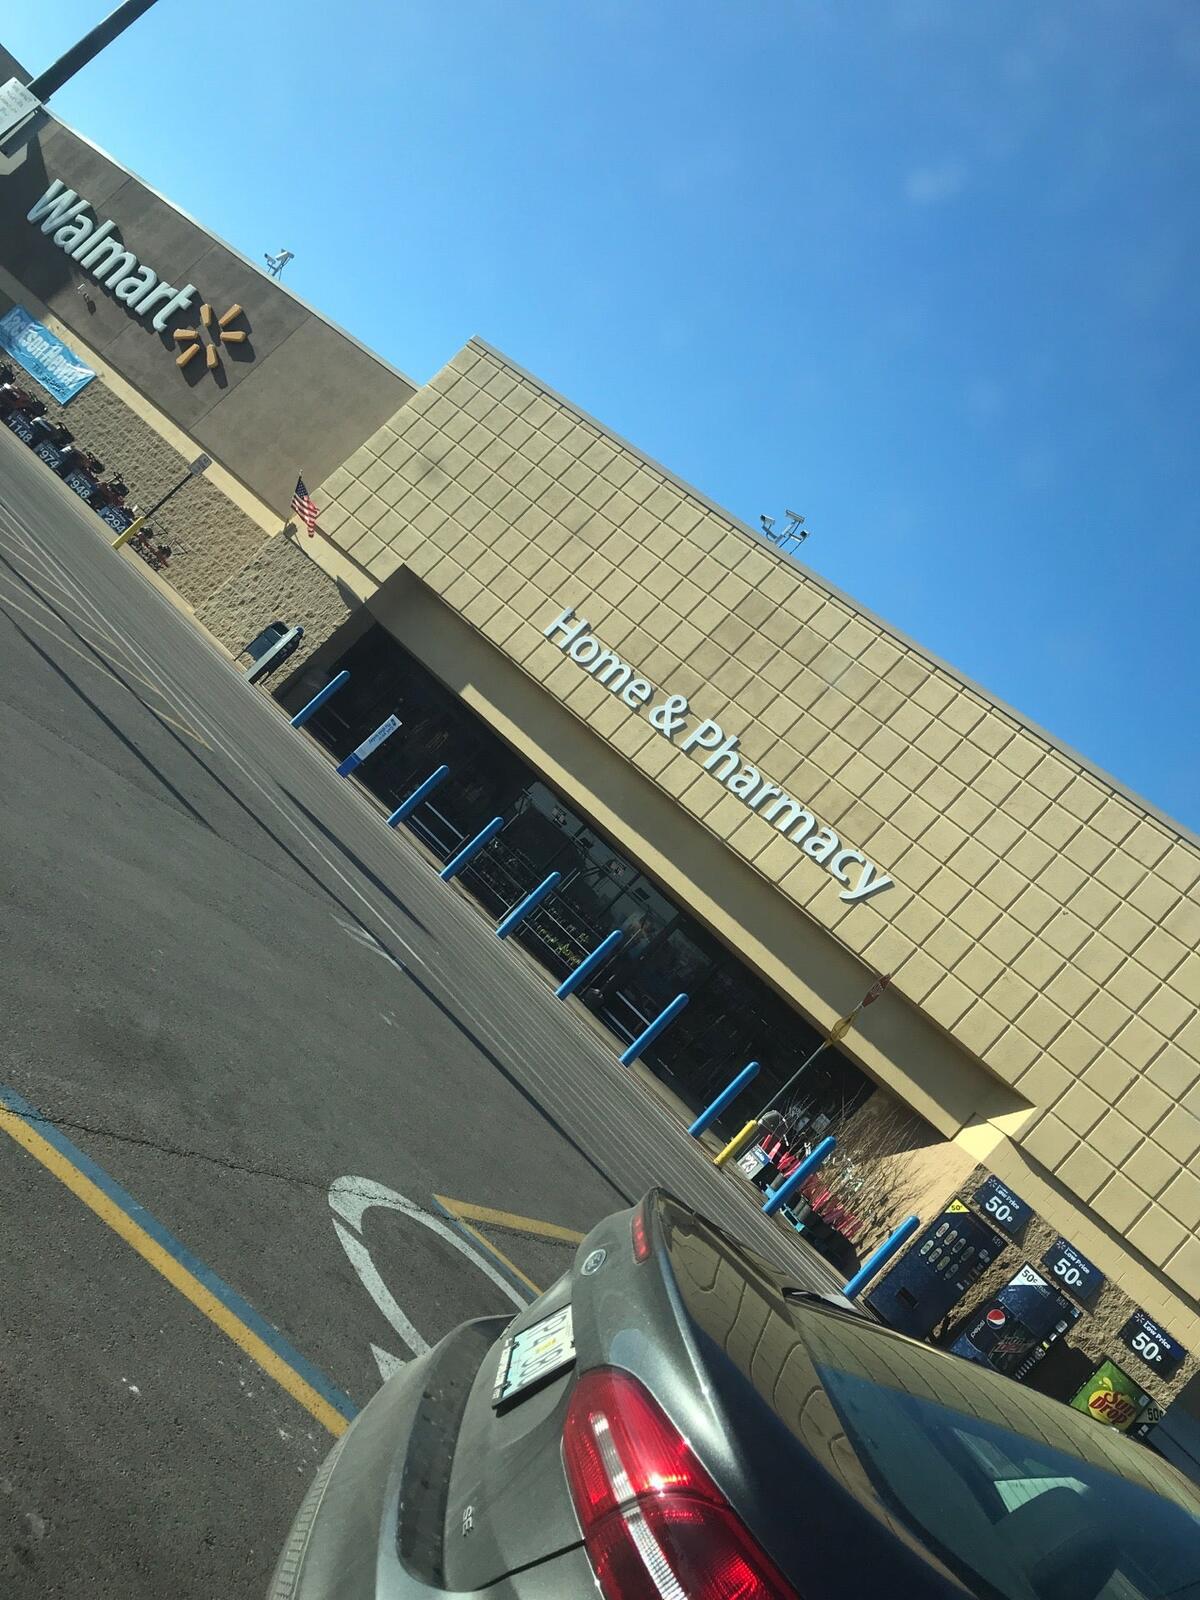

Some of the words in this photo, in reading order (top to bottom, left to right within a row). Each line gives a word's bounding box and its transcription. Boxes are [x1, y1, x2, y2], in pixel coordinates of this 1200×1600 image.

[27, 179, 197, 333] Walmart
[543, 606, 652, 709] Home
[649, 694, 689, 738] &
[681, 718, 895, 902] Pharmacy
[994, 1185, 1007, 1198] Low
[1005, 1195, 1020, 1210] Price
[1063, 1248, 1077, 1261] Low
[1075, 1258, 1090, 1274] Price
[970, 1319, 985, 1338] pepsi
[1142, 1321, 1157, 1336] Low
[1155, 1332, 1171, 1349] Price
[1089, 1396, 1128, 1425] Drop
[1104, 1391, 1136, 1416] Sun
[462, 1505, 473, 1535] SE
